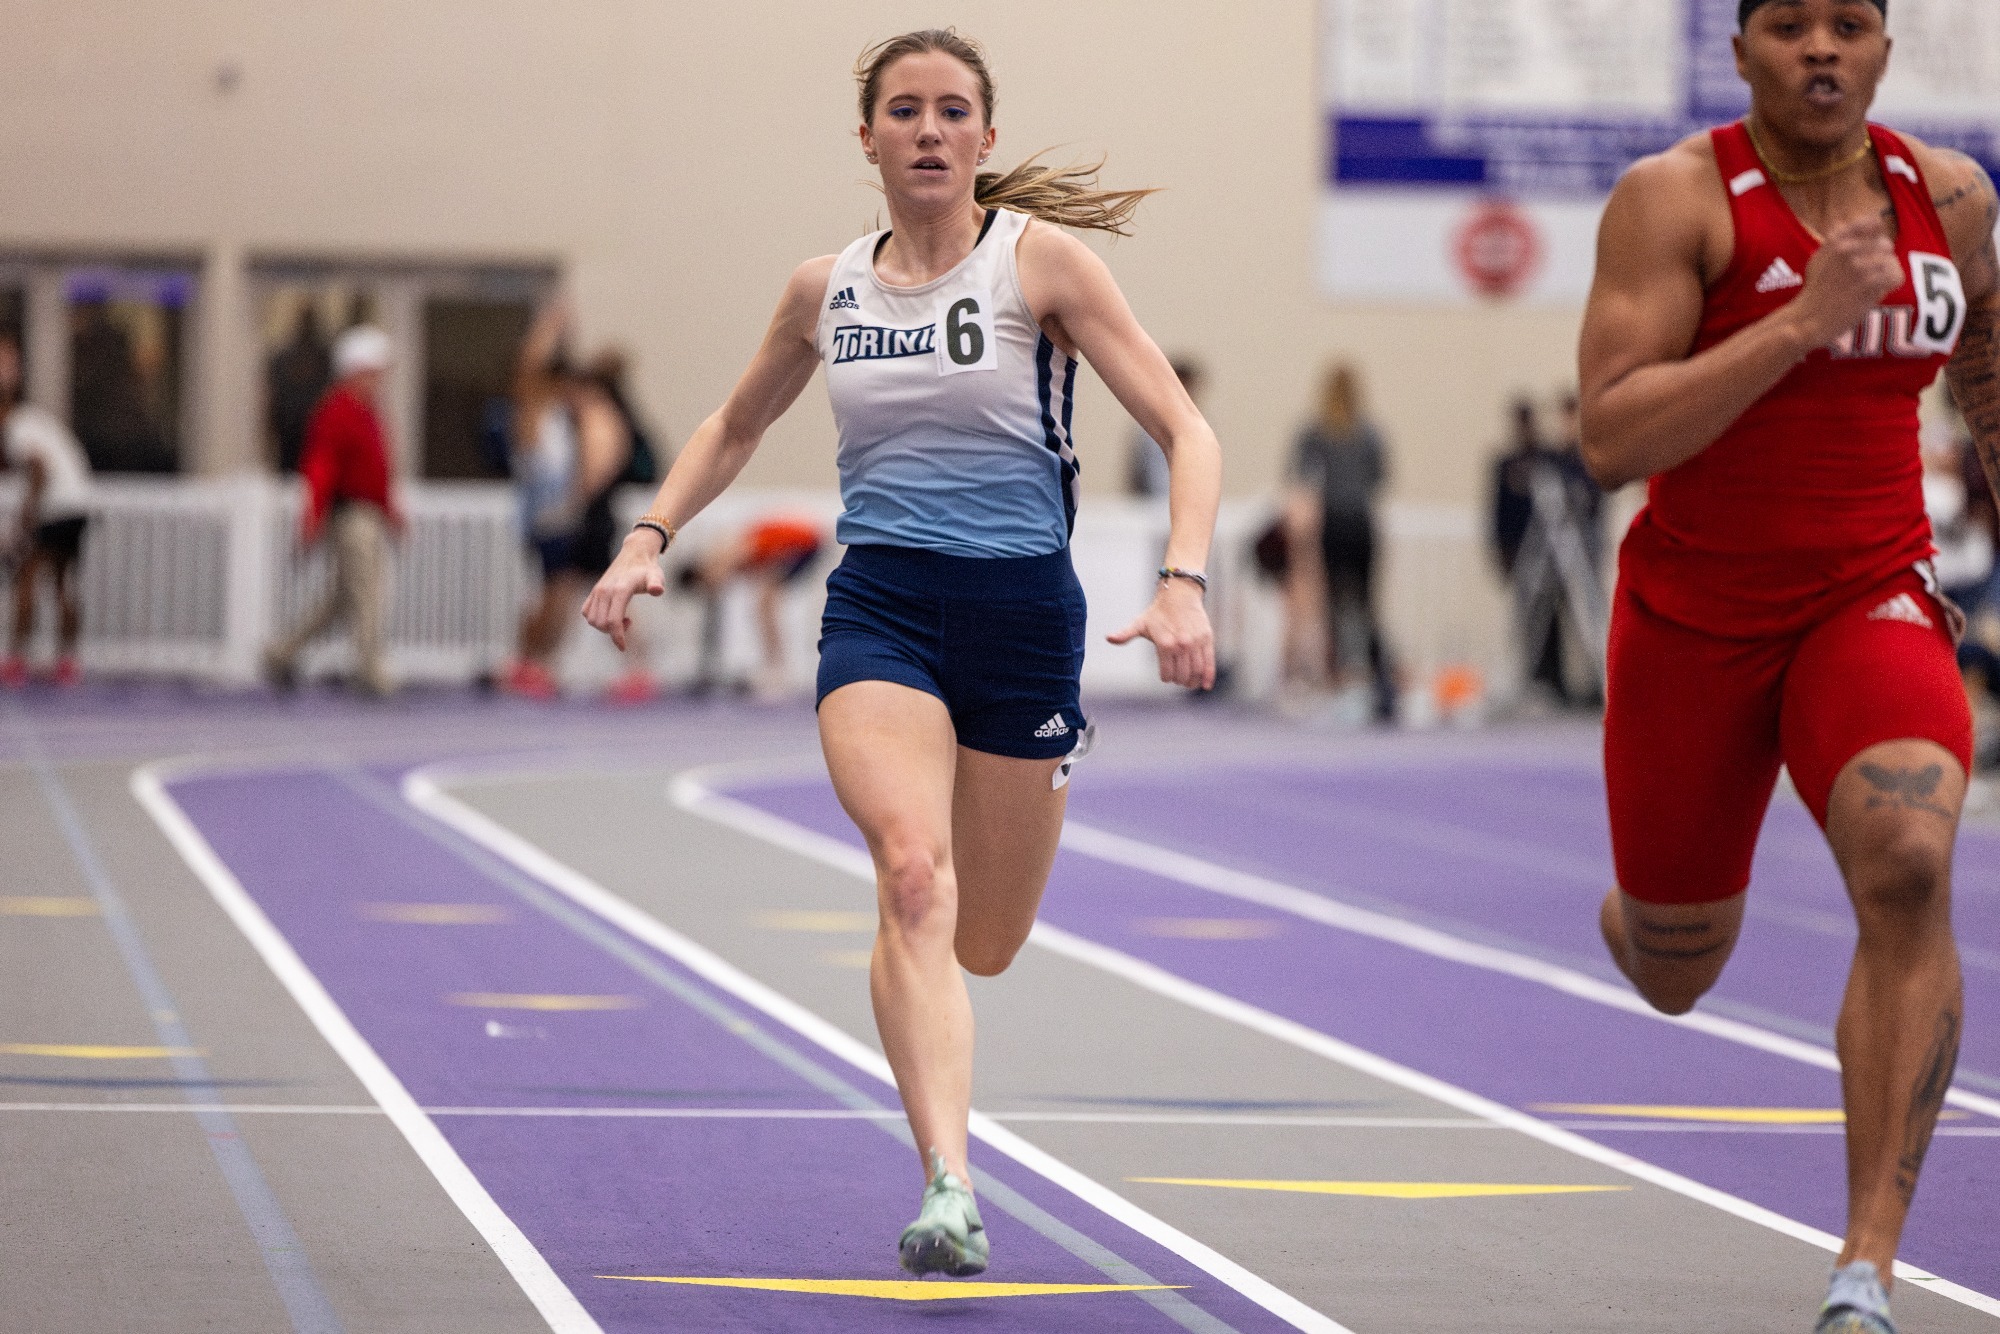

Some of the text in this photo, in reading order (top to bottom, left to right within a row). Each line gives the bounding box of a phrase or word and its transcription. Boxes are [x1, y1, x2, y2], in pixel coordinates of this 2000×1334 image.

[829, 299, 860, 310] adidas
[1923, 262, 1956, 341] 5
[946, 297, 984, 365] 6
[1034, 726, 1069, 738] adidas
